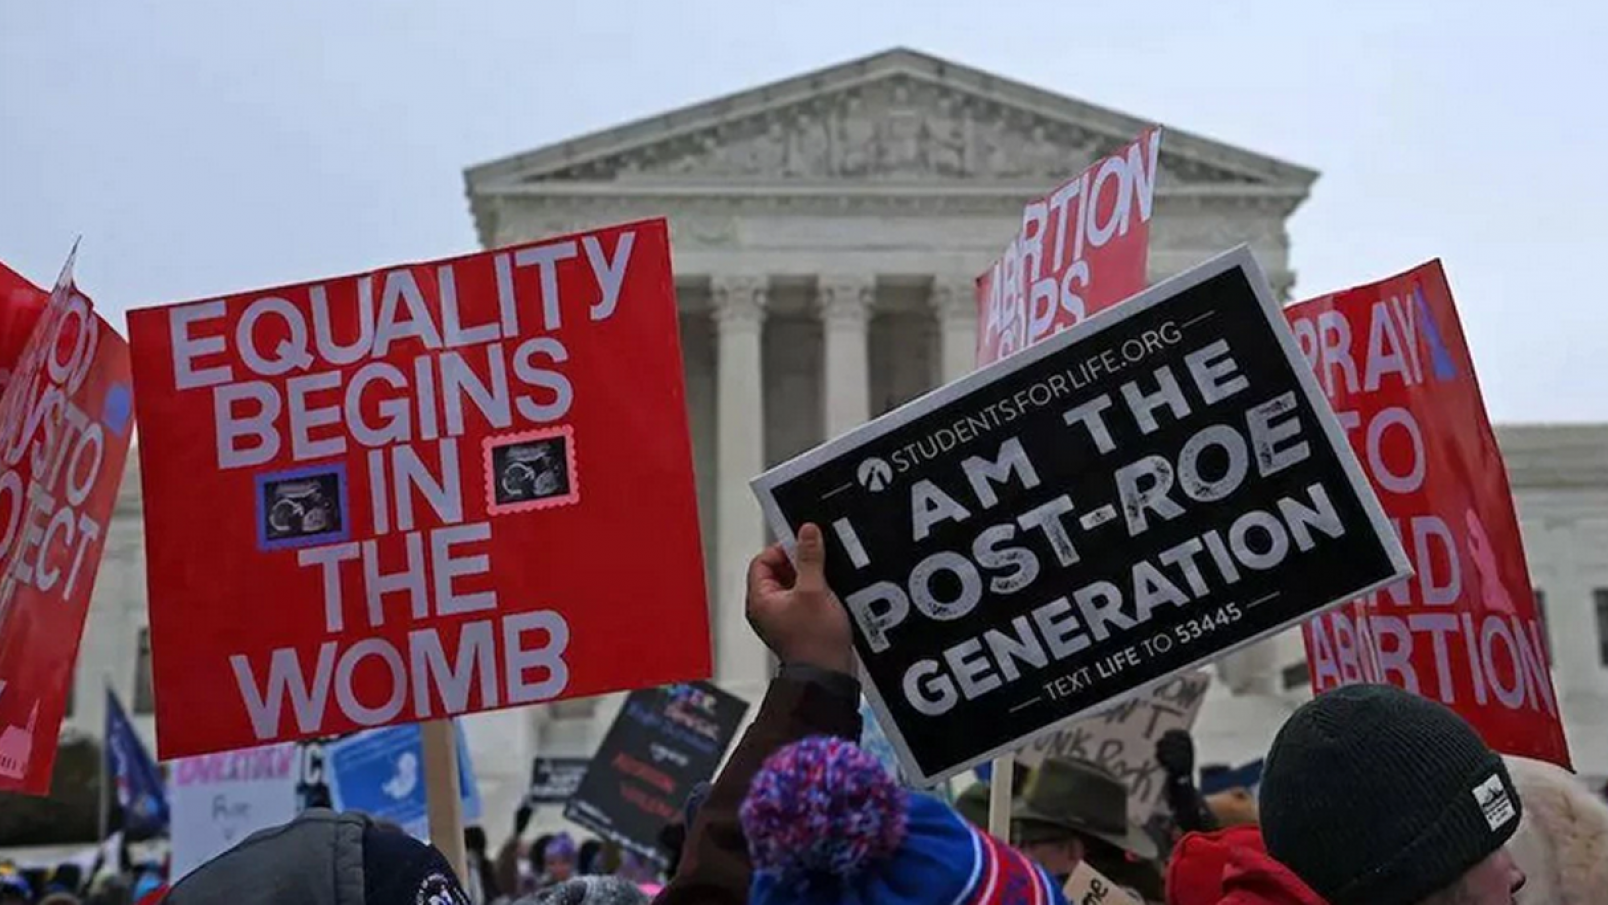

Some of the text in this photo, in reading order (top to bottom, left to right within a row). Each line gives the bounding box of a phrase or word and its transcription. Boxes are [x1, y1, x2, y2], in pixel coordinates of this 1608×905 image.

[985, 127, 1161, 344] ABRTION
[214, 337, 573, 469] BEGINS
[831, 339, 1250, 569] I AM THE
[891, 320, 1182, 473] STUDENTSFORLIFE.ORG
[367, 437, 464, 535] IN
[845, 391, 1311, 654] POST-ROE
[298, 522, 497, 633] THE
[903, 483, 1346, 716] GENERATION
[229, 609, 570, 741] WOMB
[1043, 602, 1243, 701] TEXT LIFE TO 53445
[1311, 611, 1556, 714] ABRTION
